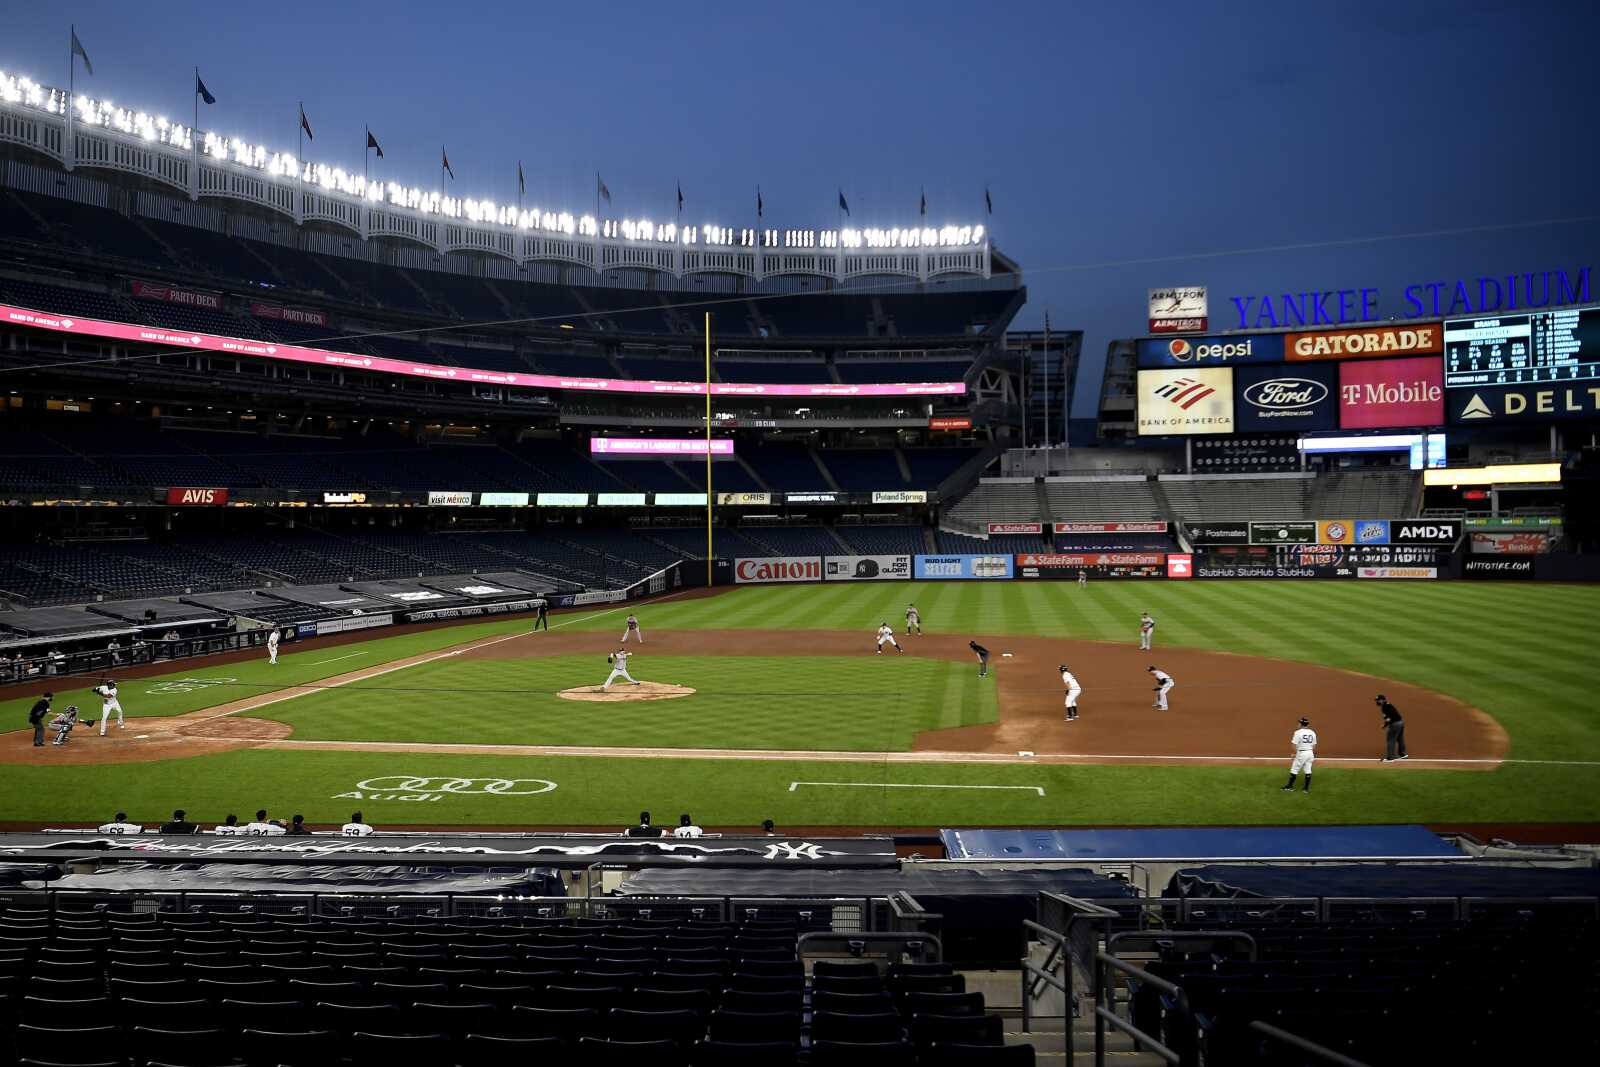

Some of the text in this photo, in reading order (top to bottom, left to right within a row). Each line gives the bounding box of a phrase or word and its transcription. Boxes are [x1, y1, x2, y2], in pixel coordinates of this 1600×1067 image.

[170, 290, 195, 305] PARTY
[196, 295, 218, 308] DECK
[1152, 291, 1205, 300] ARMITRON
[1230, 266, 1592, 329] YANKEE STADIUM
[283, 308, 304, 321] PARTY
[34, 318, 61, 327] AMERICA
[1154, 318, 1202, 328] ARMITRON
[1294, 327, 1433, 356] GATORADE
[1196, 339, 1252, 361] pepsi
[1258, 382, 1314, 404] Ford
[1343, 380, 1442, 405] T Mobile
[1140, 416, 1232, 427] BANK OF AMERICA
[181, 489, 214, 503] AVIS
[431, 494, 446, 503] visit
[742, 493, 766, 503] ORIS
[875, 492, 924, 505] Poland Spring
[1205, 529, 1247, 538] Postmates
[1399, 526, 1439, 539] AMD
[736, 559, 820, 581] Canon
[1198, 568, 1315, 577] StubHub StubHub StubHub
[1302, 734, 1314, 744] 50
[329, 790, 443, 801] Audi
